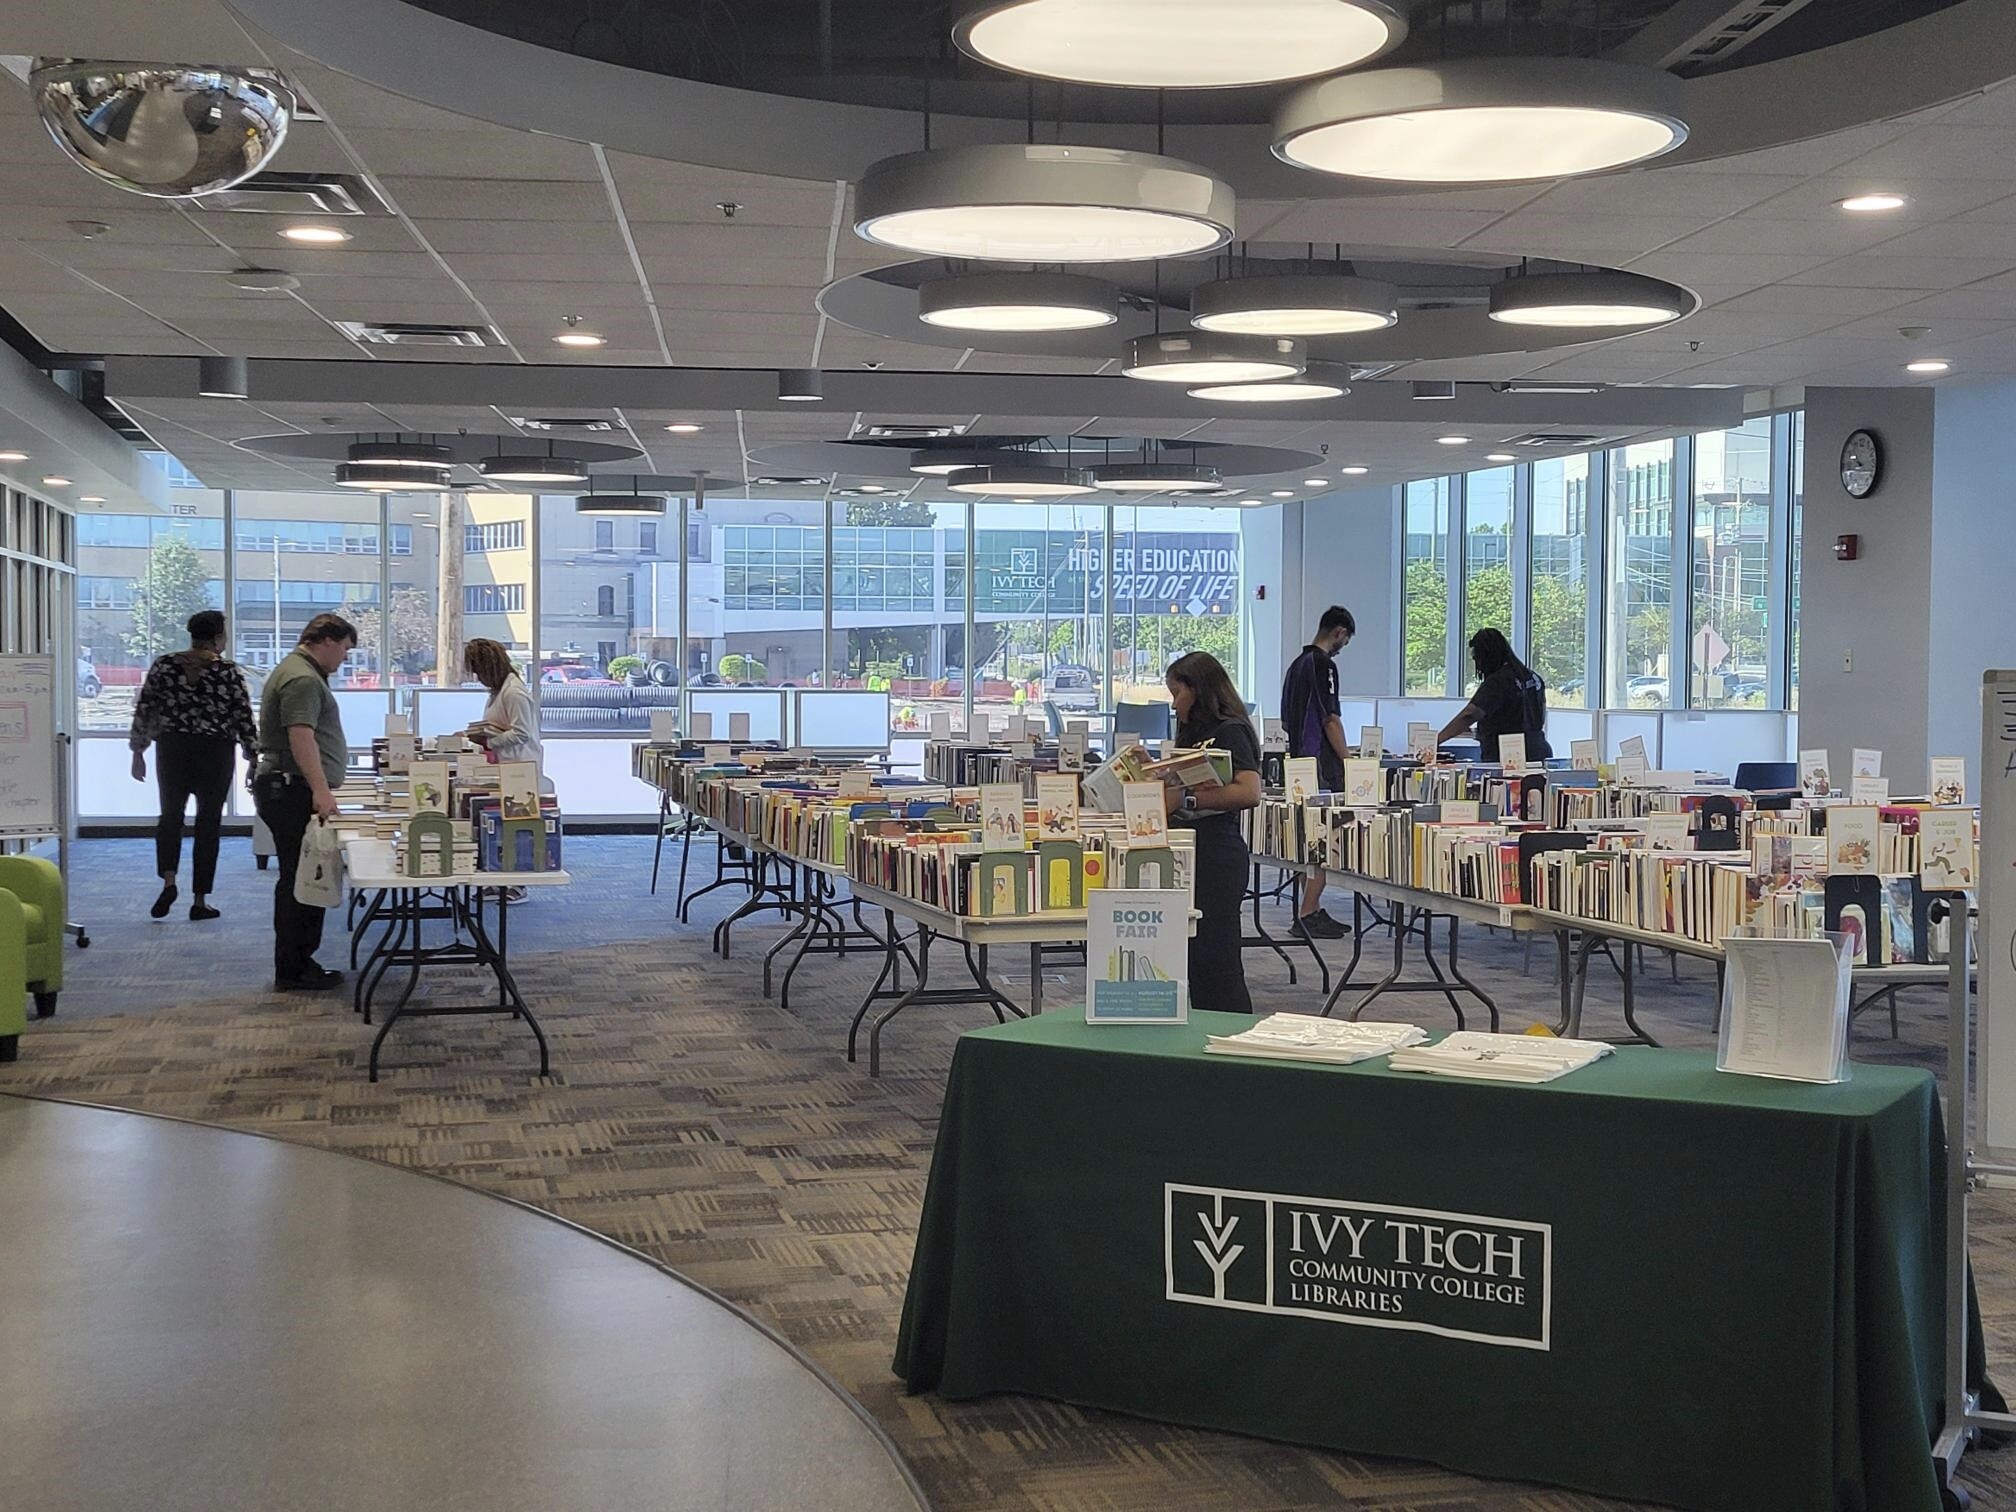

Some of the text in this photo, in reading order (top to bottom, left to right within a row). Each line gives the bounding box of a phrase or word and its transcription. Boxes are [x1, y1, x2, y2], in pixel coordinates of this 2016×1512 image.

[1142, 549, 1240, 572] EDUCATION
[992, 576, 1016, 588] IVY
[1158, 575, 1193, 600] OF
[1190, 575, 1239, 600] LIFE
[1113, 910, 1164, 924] BOOK
[1115, 925, 1158, 938] FAIR
[1289, 1210, 1525, 1280] IVY TECH
[1289, 1259, 1526, 1305] COMMUNITY COLLEGE
[1290, 1283, 1404, 1314] LIBRARIES
